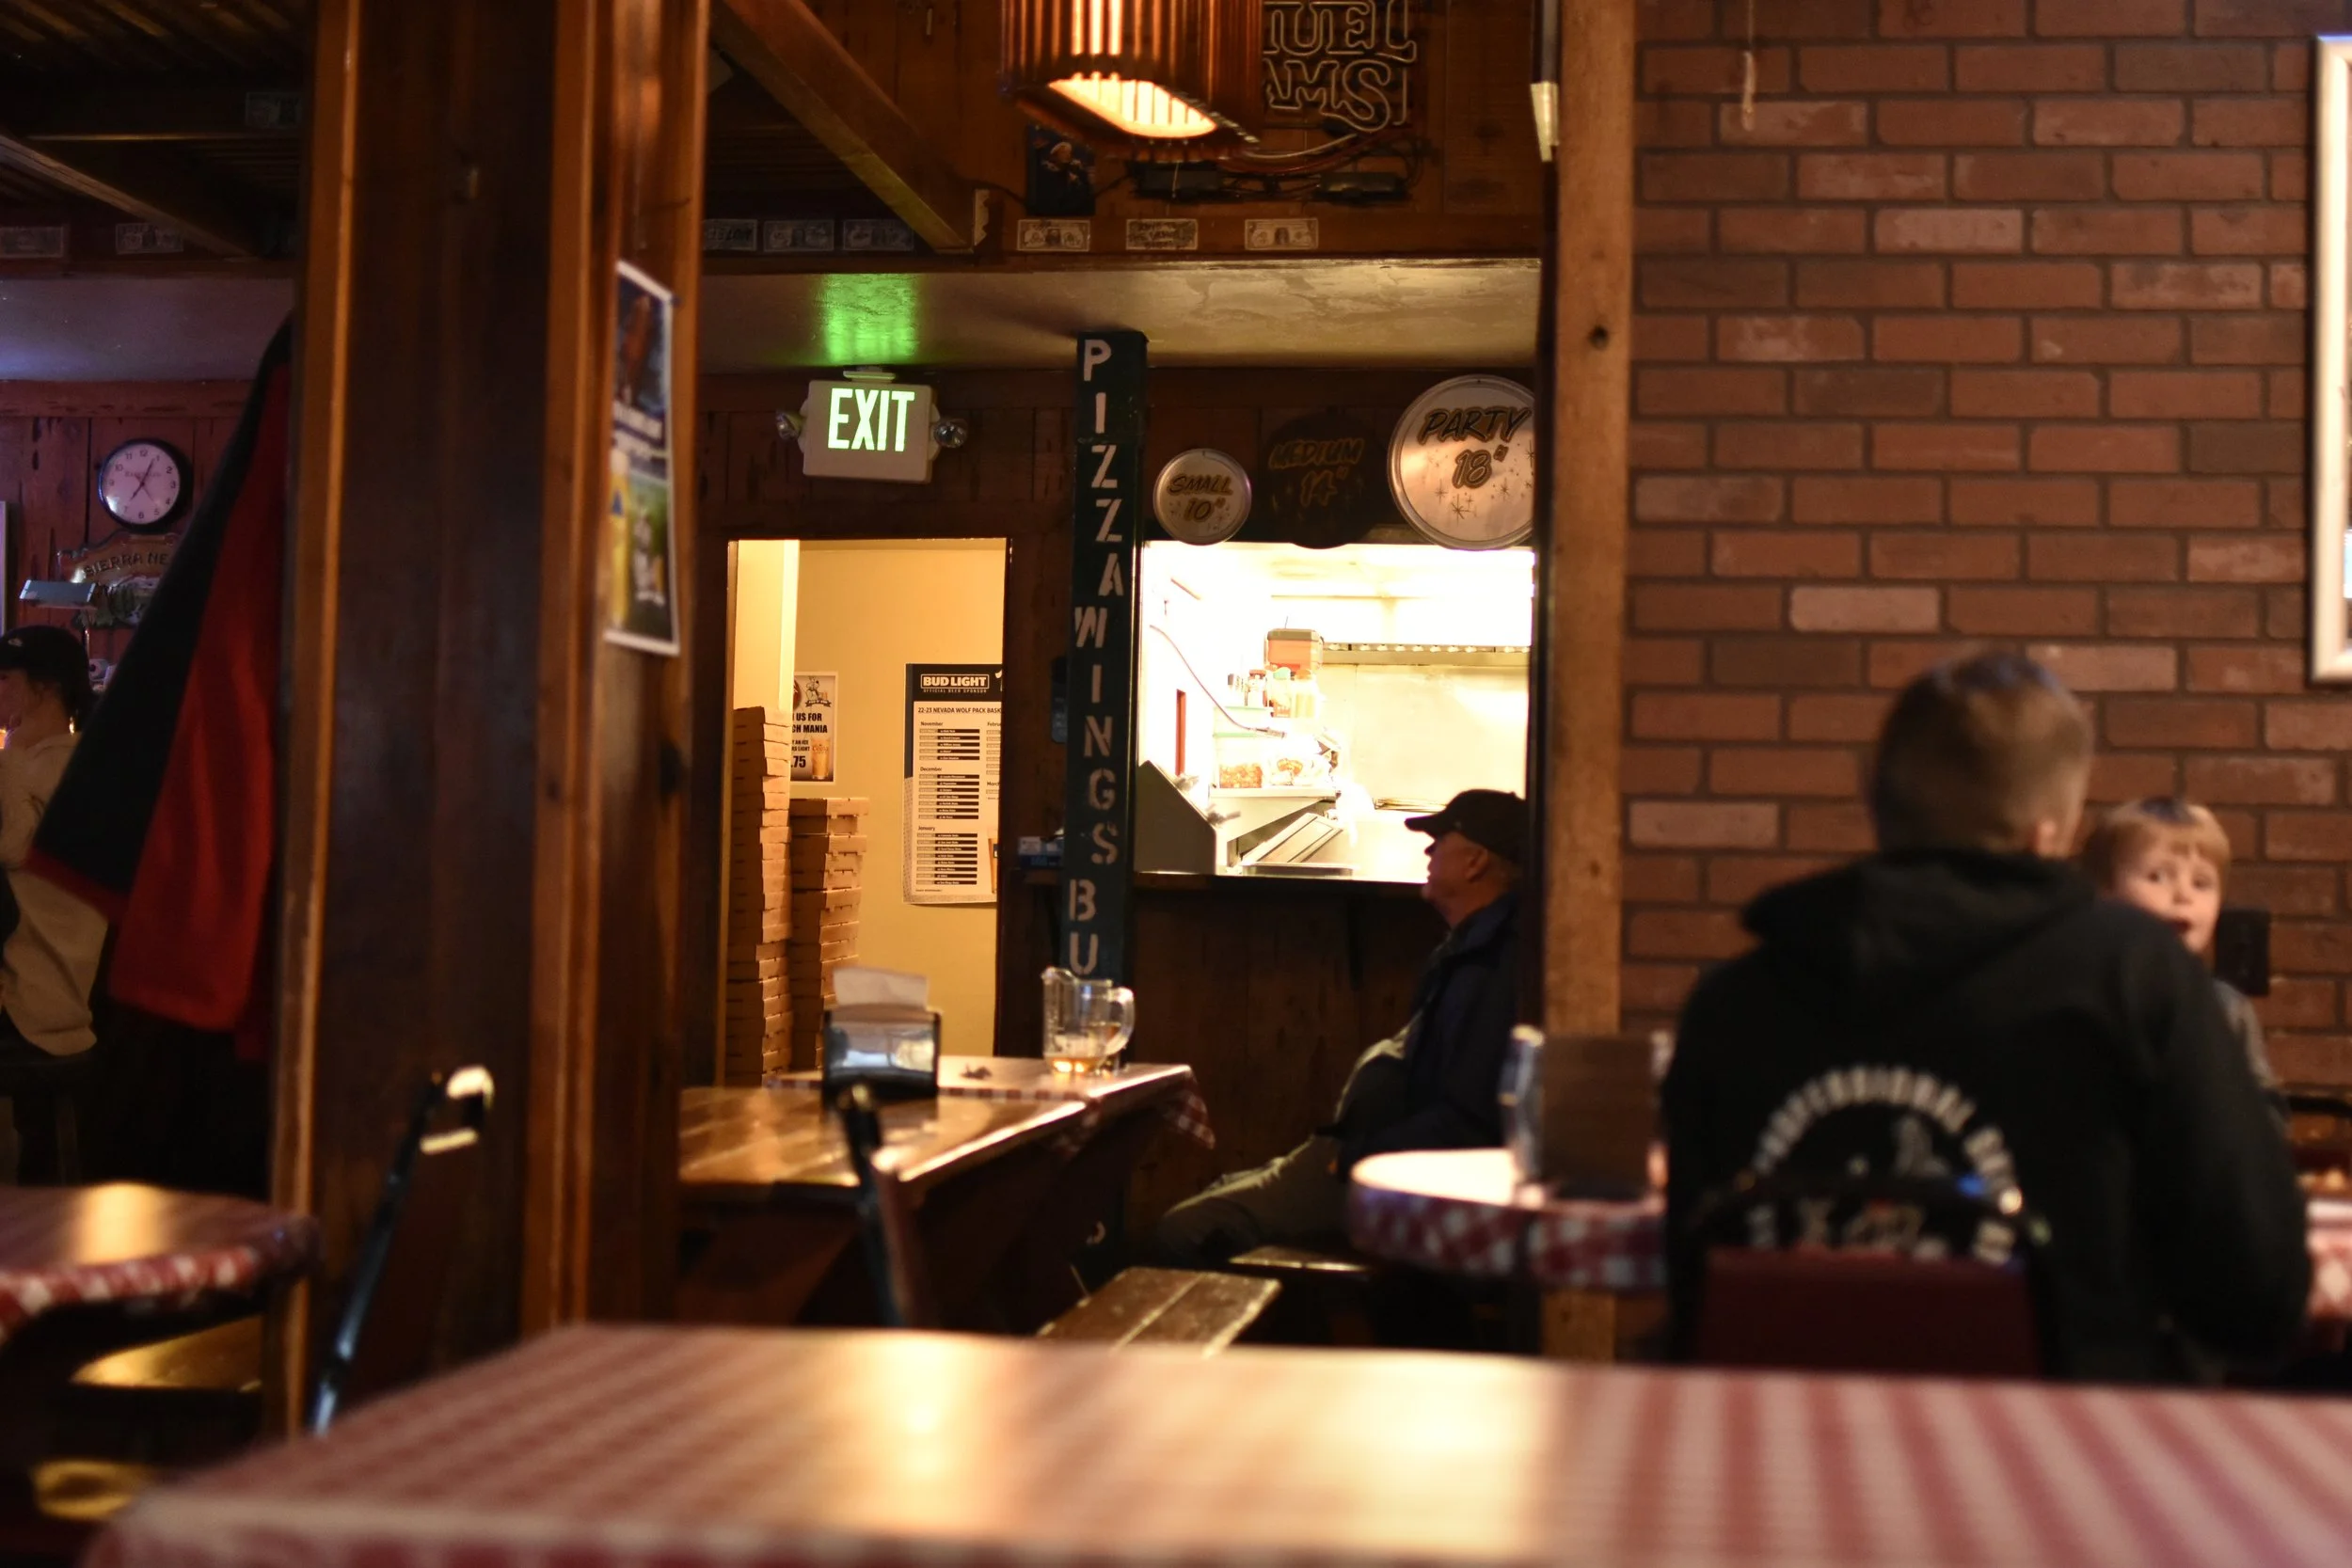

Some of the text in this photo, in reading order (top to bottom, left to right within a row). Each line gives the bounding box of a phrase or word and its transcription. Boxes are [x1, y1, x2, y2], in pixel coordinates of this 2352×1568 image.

[1263, 0, 1417, 62] UEL
[1263, 58, 1391, 132] AMS
[827, 388, 915, 452] EXIT
[1417, 405, 1533, 446] PARTY
[1084, 339, 1124, 596] PIZZA
[1268, 437, 1365, 469] MEDIUM
[1167, 473, 1234, 497] SMALL
[86, 552, 169, 576] SIERRA NE
[923, 676, 987, 687] BUD LIGHT
[792, 724, 828, 733] CH MANIA
[796, 713, 806, 721] US
[808, 713, 822, 721] FOR
[1074, 606, 1119, 864] WINGS
[790, 755, 806, 768] .75
[1069, 879, 1099, 974] BU
